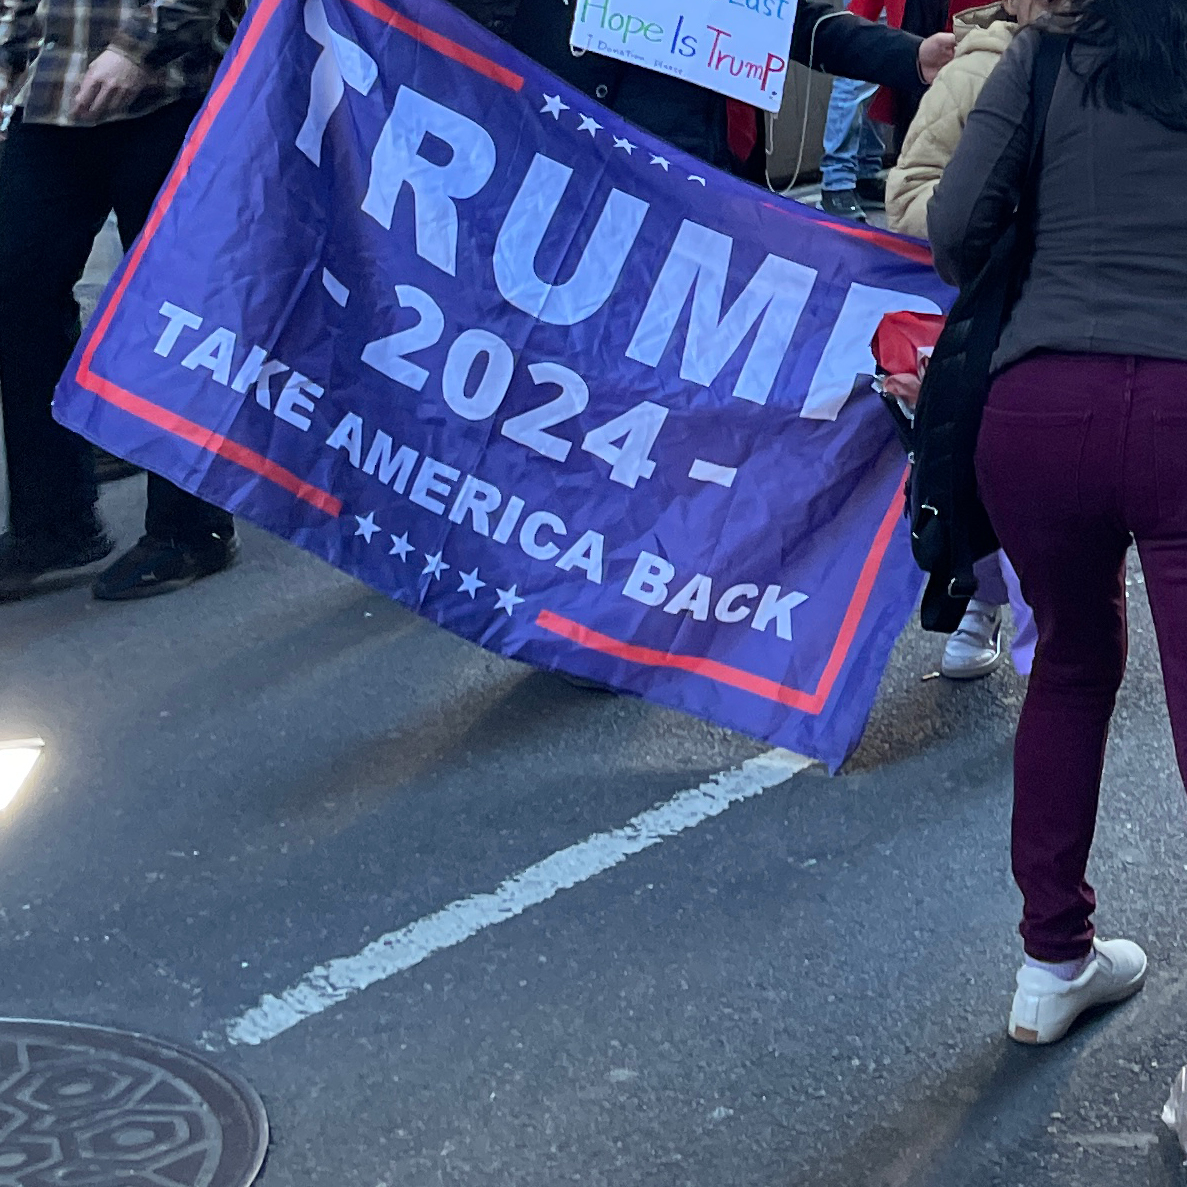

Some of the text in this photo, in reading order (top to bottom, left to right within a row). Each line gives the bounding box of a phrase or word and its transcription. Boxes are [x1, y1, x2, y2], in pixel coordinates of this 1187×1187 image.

[670, 14, 699, 58] Is
[150, 300, 810, 643] TAKE AMERICA BACK
